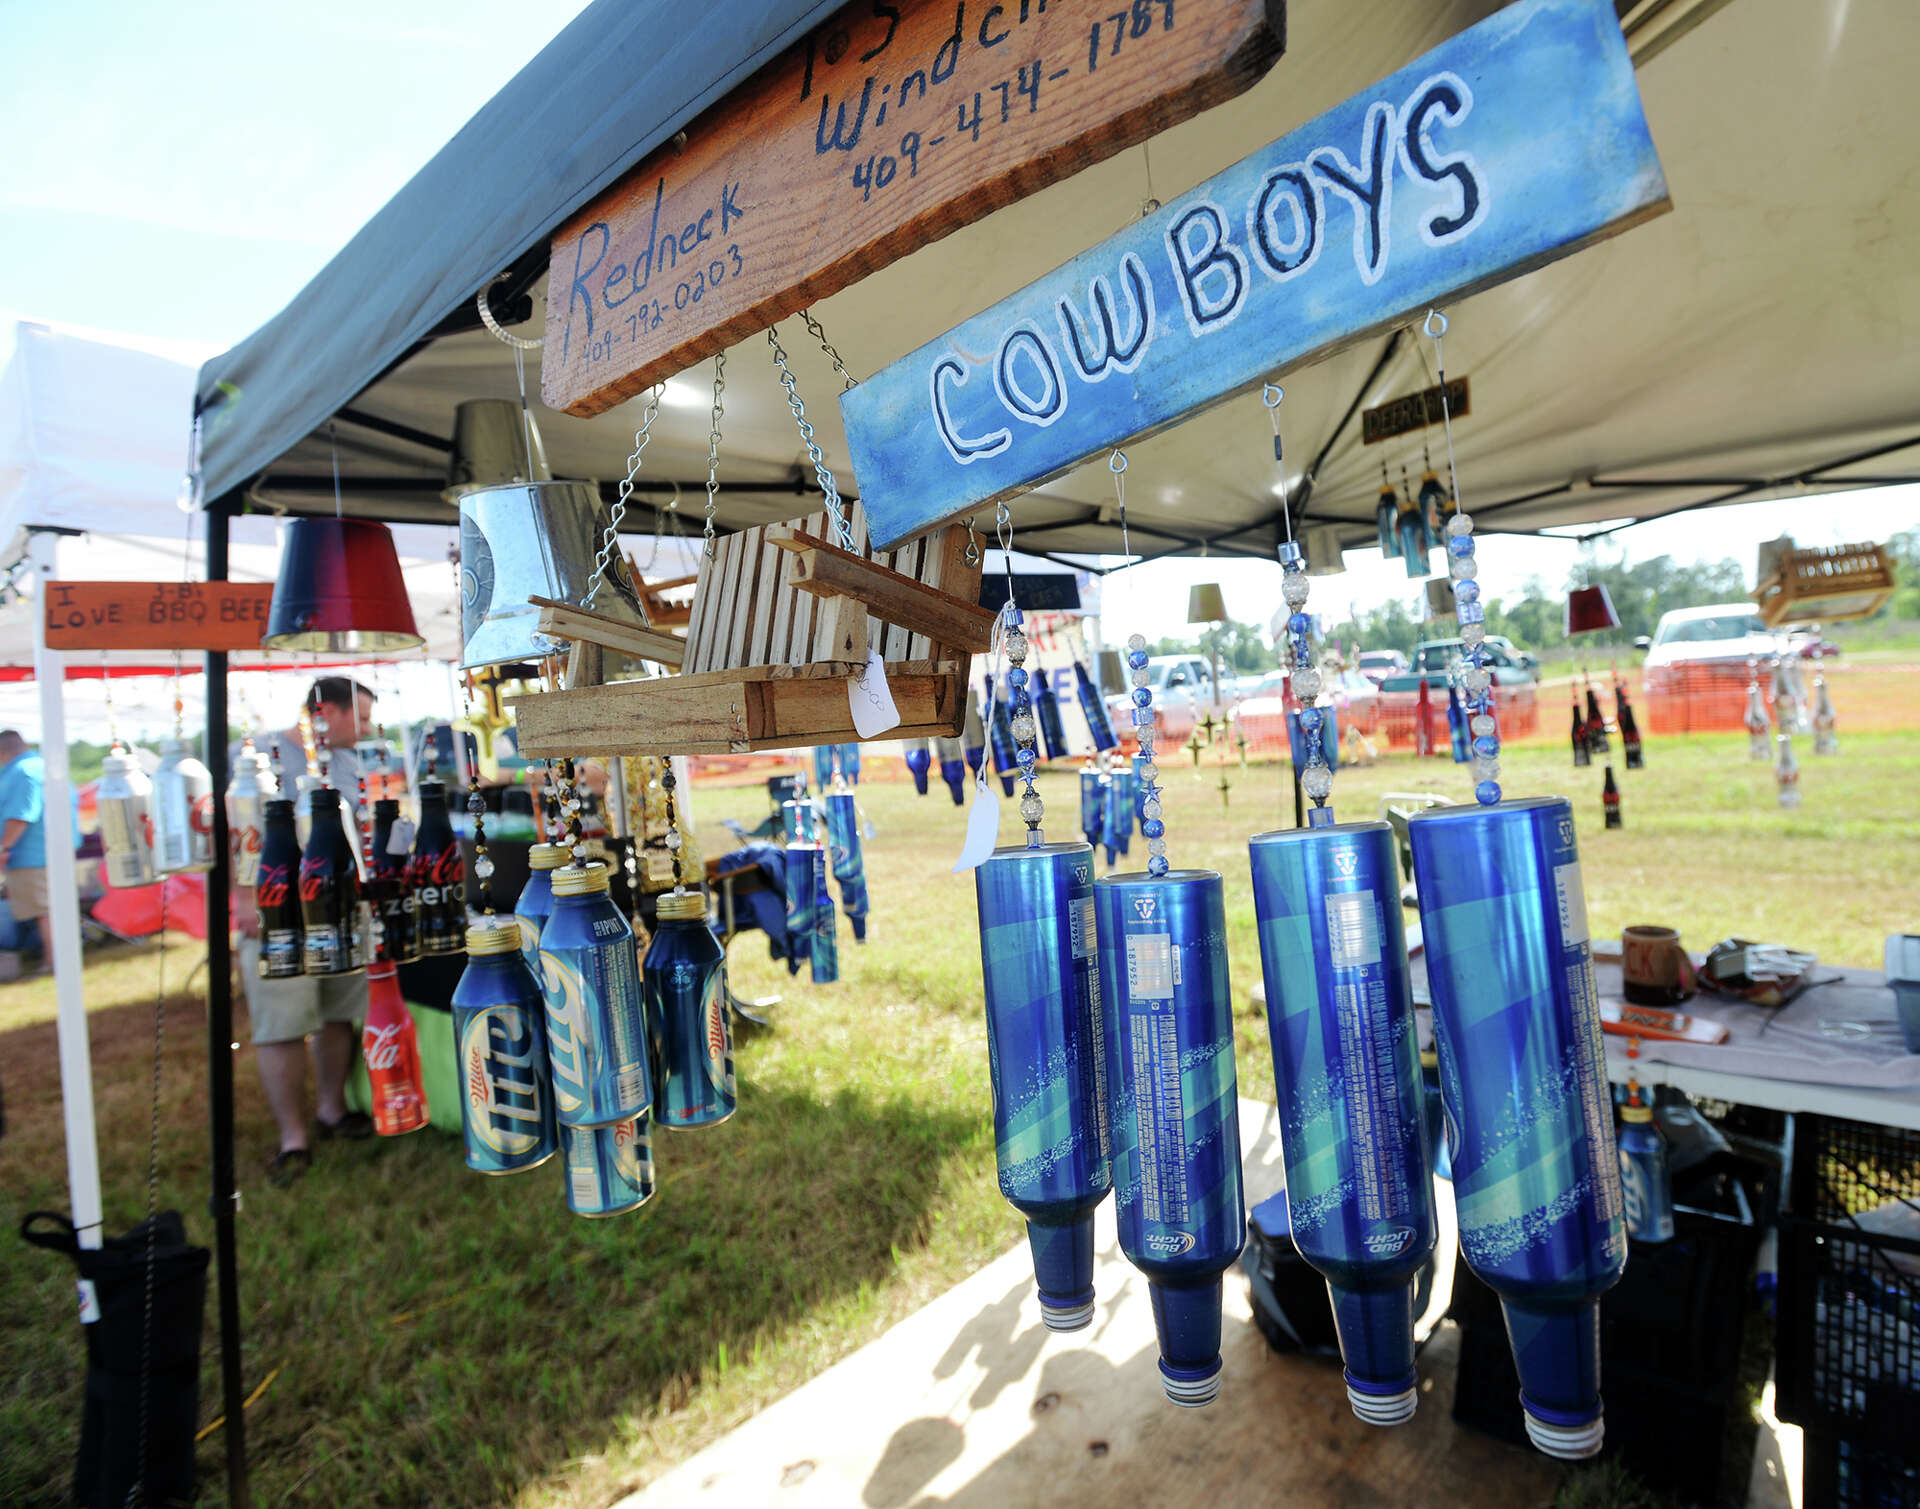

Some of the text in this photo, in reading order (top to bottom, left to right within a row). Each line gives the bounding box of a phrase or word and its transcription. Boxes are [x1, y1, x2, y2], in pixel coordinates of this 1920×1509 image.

[562, 177, 744, 367] Redneck
[48, 603, 122, 630] LOVE
[149, 600, 208, 626] BBQ
[707, 999, 726, 1061] Miller
[469, 1045, 489, 1109] Miller
[1149, 1242, 1181, 1253] BUD
[1368, 1241, 1405, 1254] BUD
